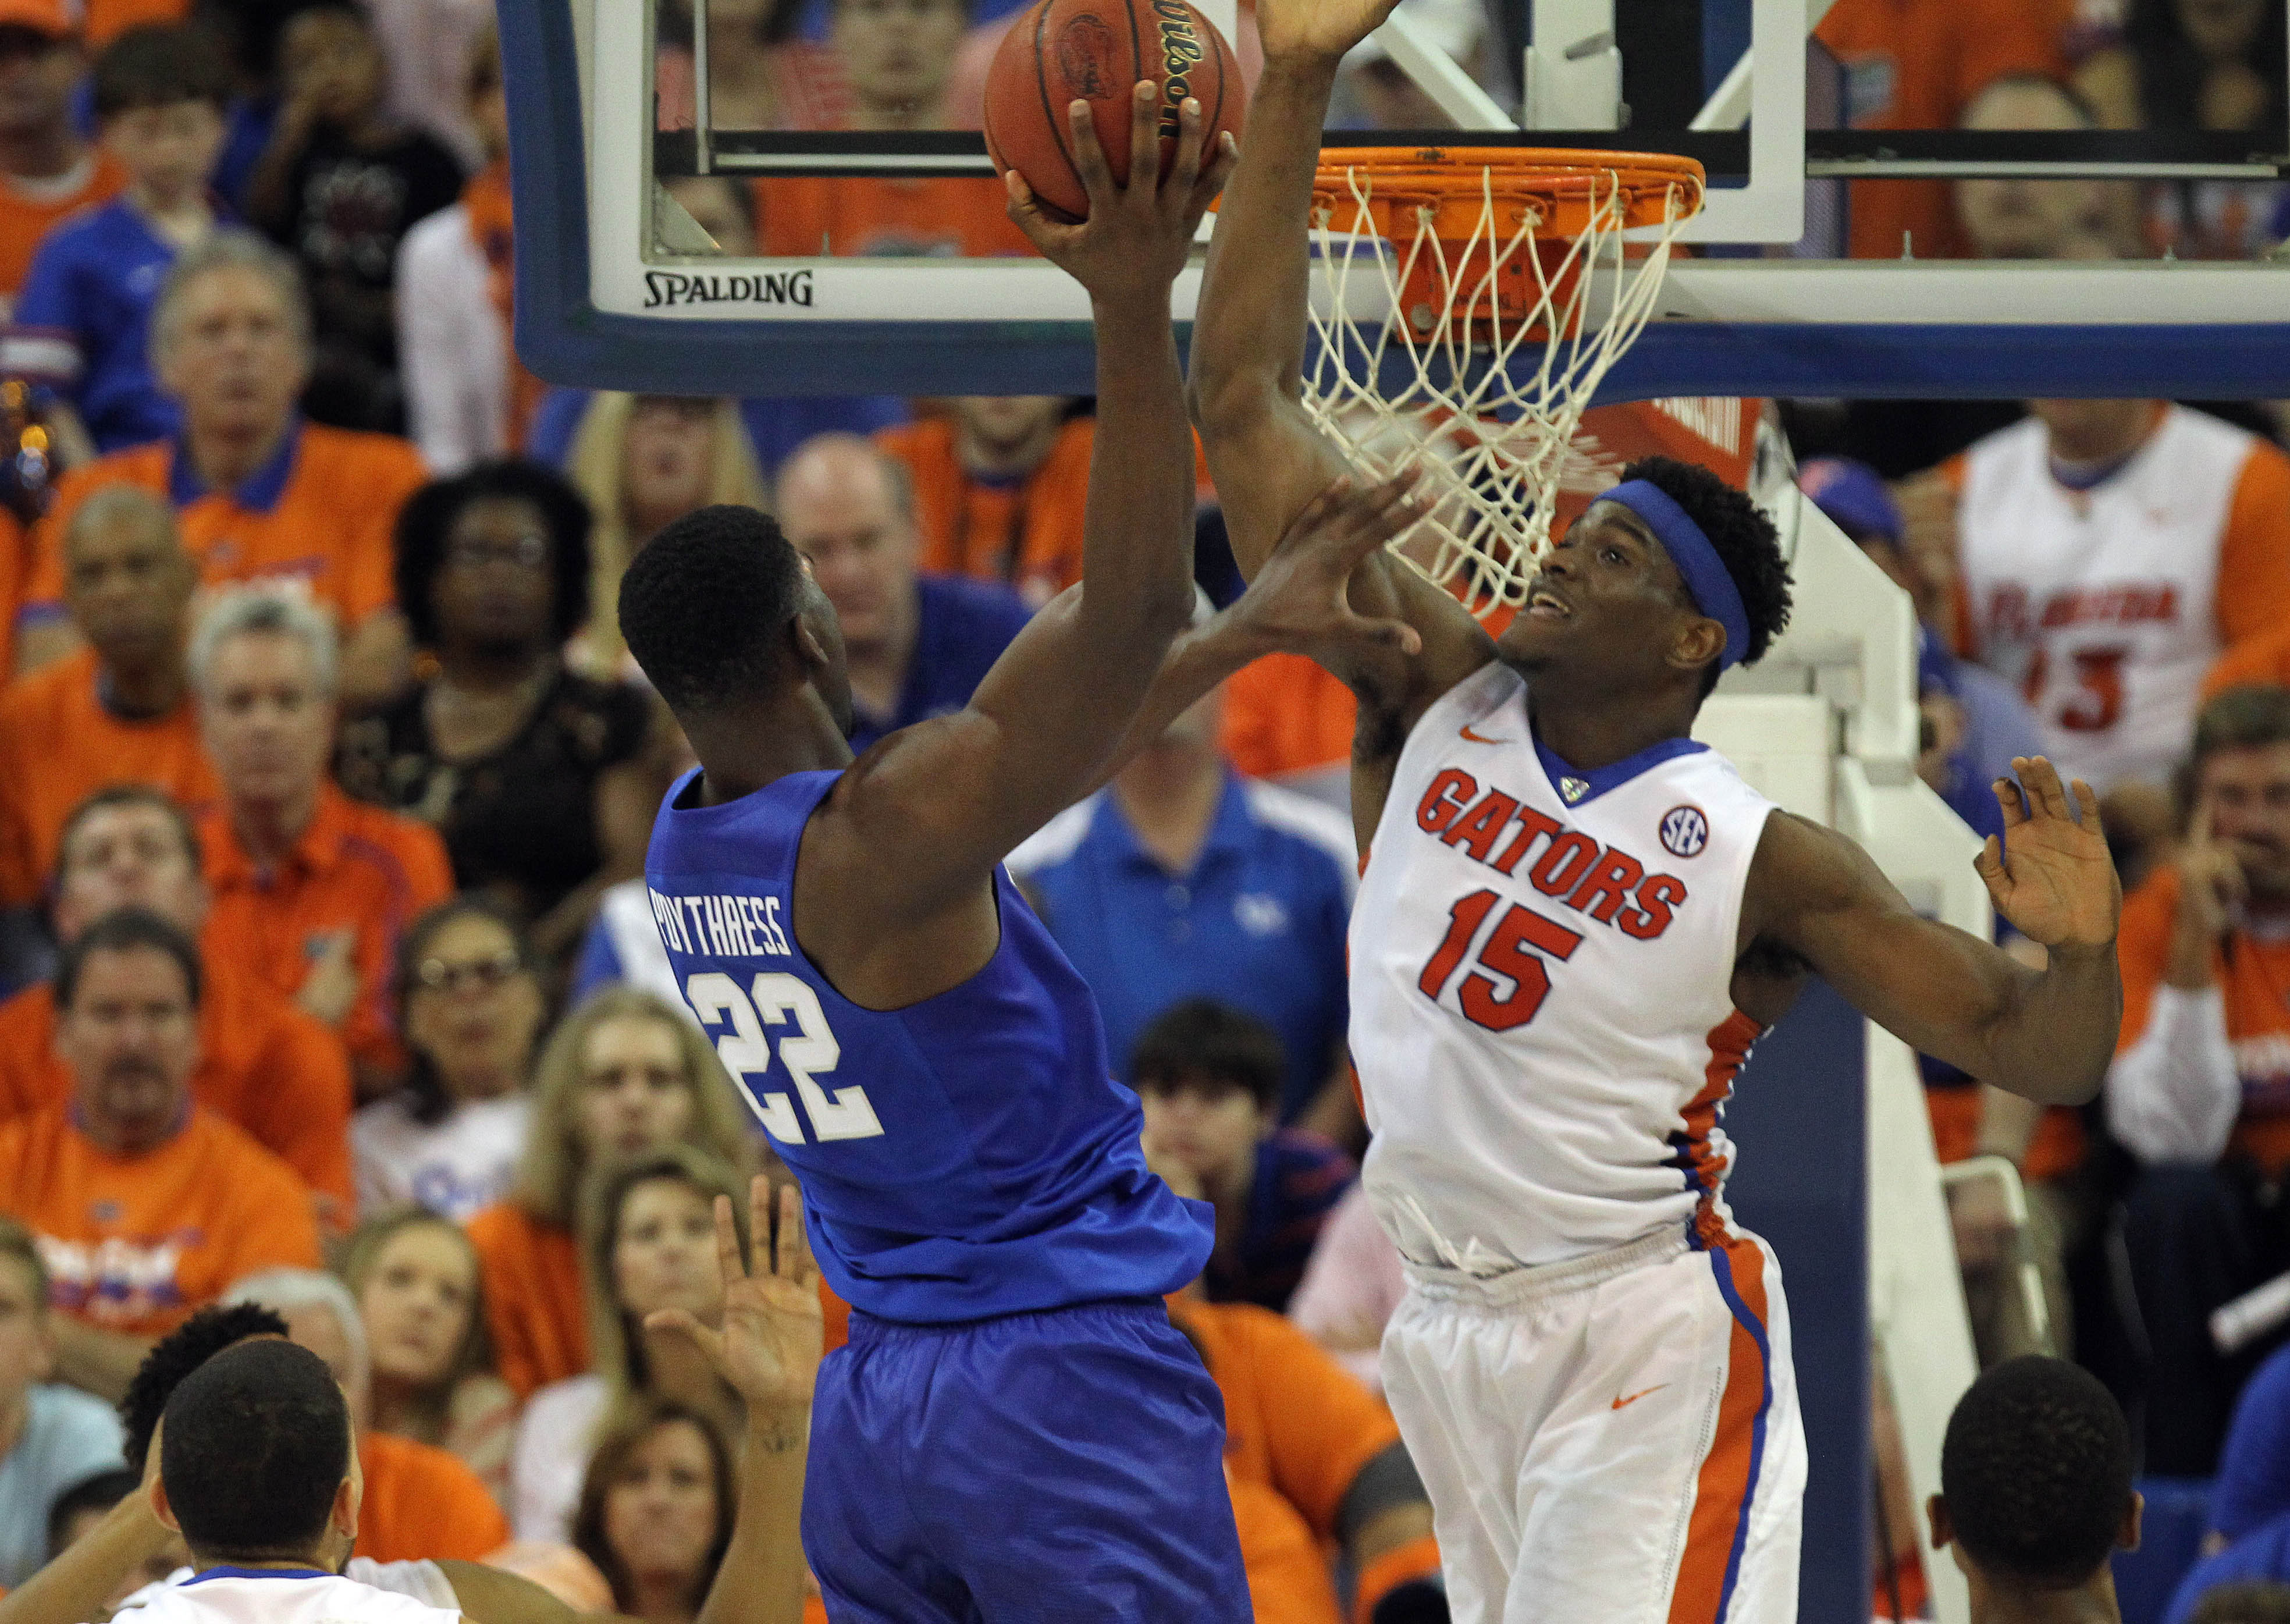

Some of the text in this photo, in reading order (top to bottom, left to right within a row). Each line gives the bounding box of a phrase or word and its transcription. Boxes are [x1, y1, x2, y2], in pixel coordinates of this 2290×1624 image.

[645, 270, 813, 307] SPALDING
[1416, 767, 1688, 940] GATORS
[1662, 808, 1706, 855] SEC
[649, 886, 792, 956] POYTHRESS
[1418, 889, 1585, 1032] 15
[687, 972, 885, 1145] 22
